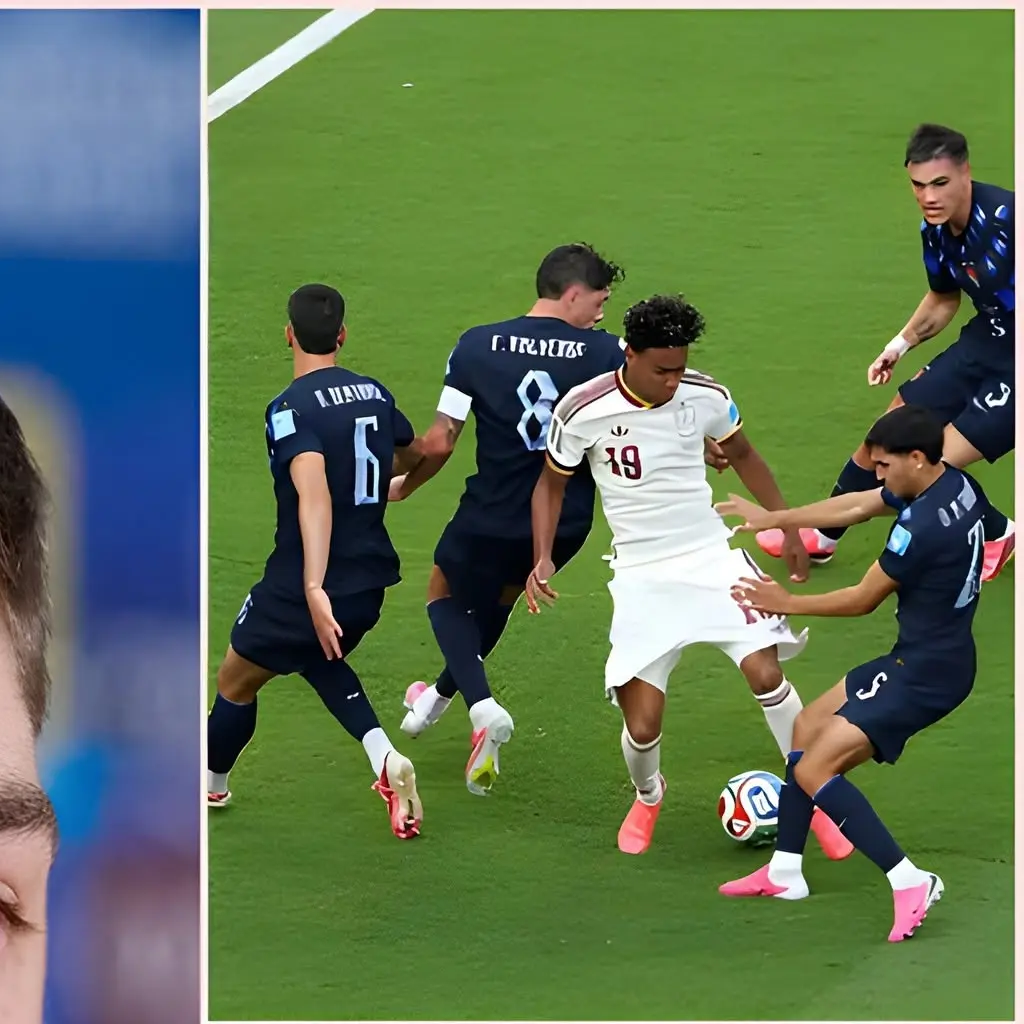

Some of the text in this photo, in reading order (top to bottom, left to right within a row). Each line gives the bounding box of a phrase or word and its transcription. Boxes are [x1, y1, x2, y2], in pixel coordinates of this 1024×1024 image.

[516, 369, 560, 451] 8
[354, 415, 380, 506] 6
[605, 444, 643, 480] 19
